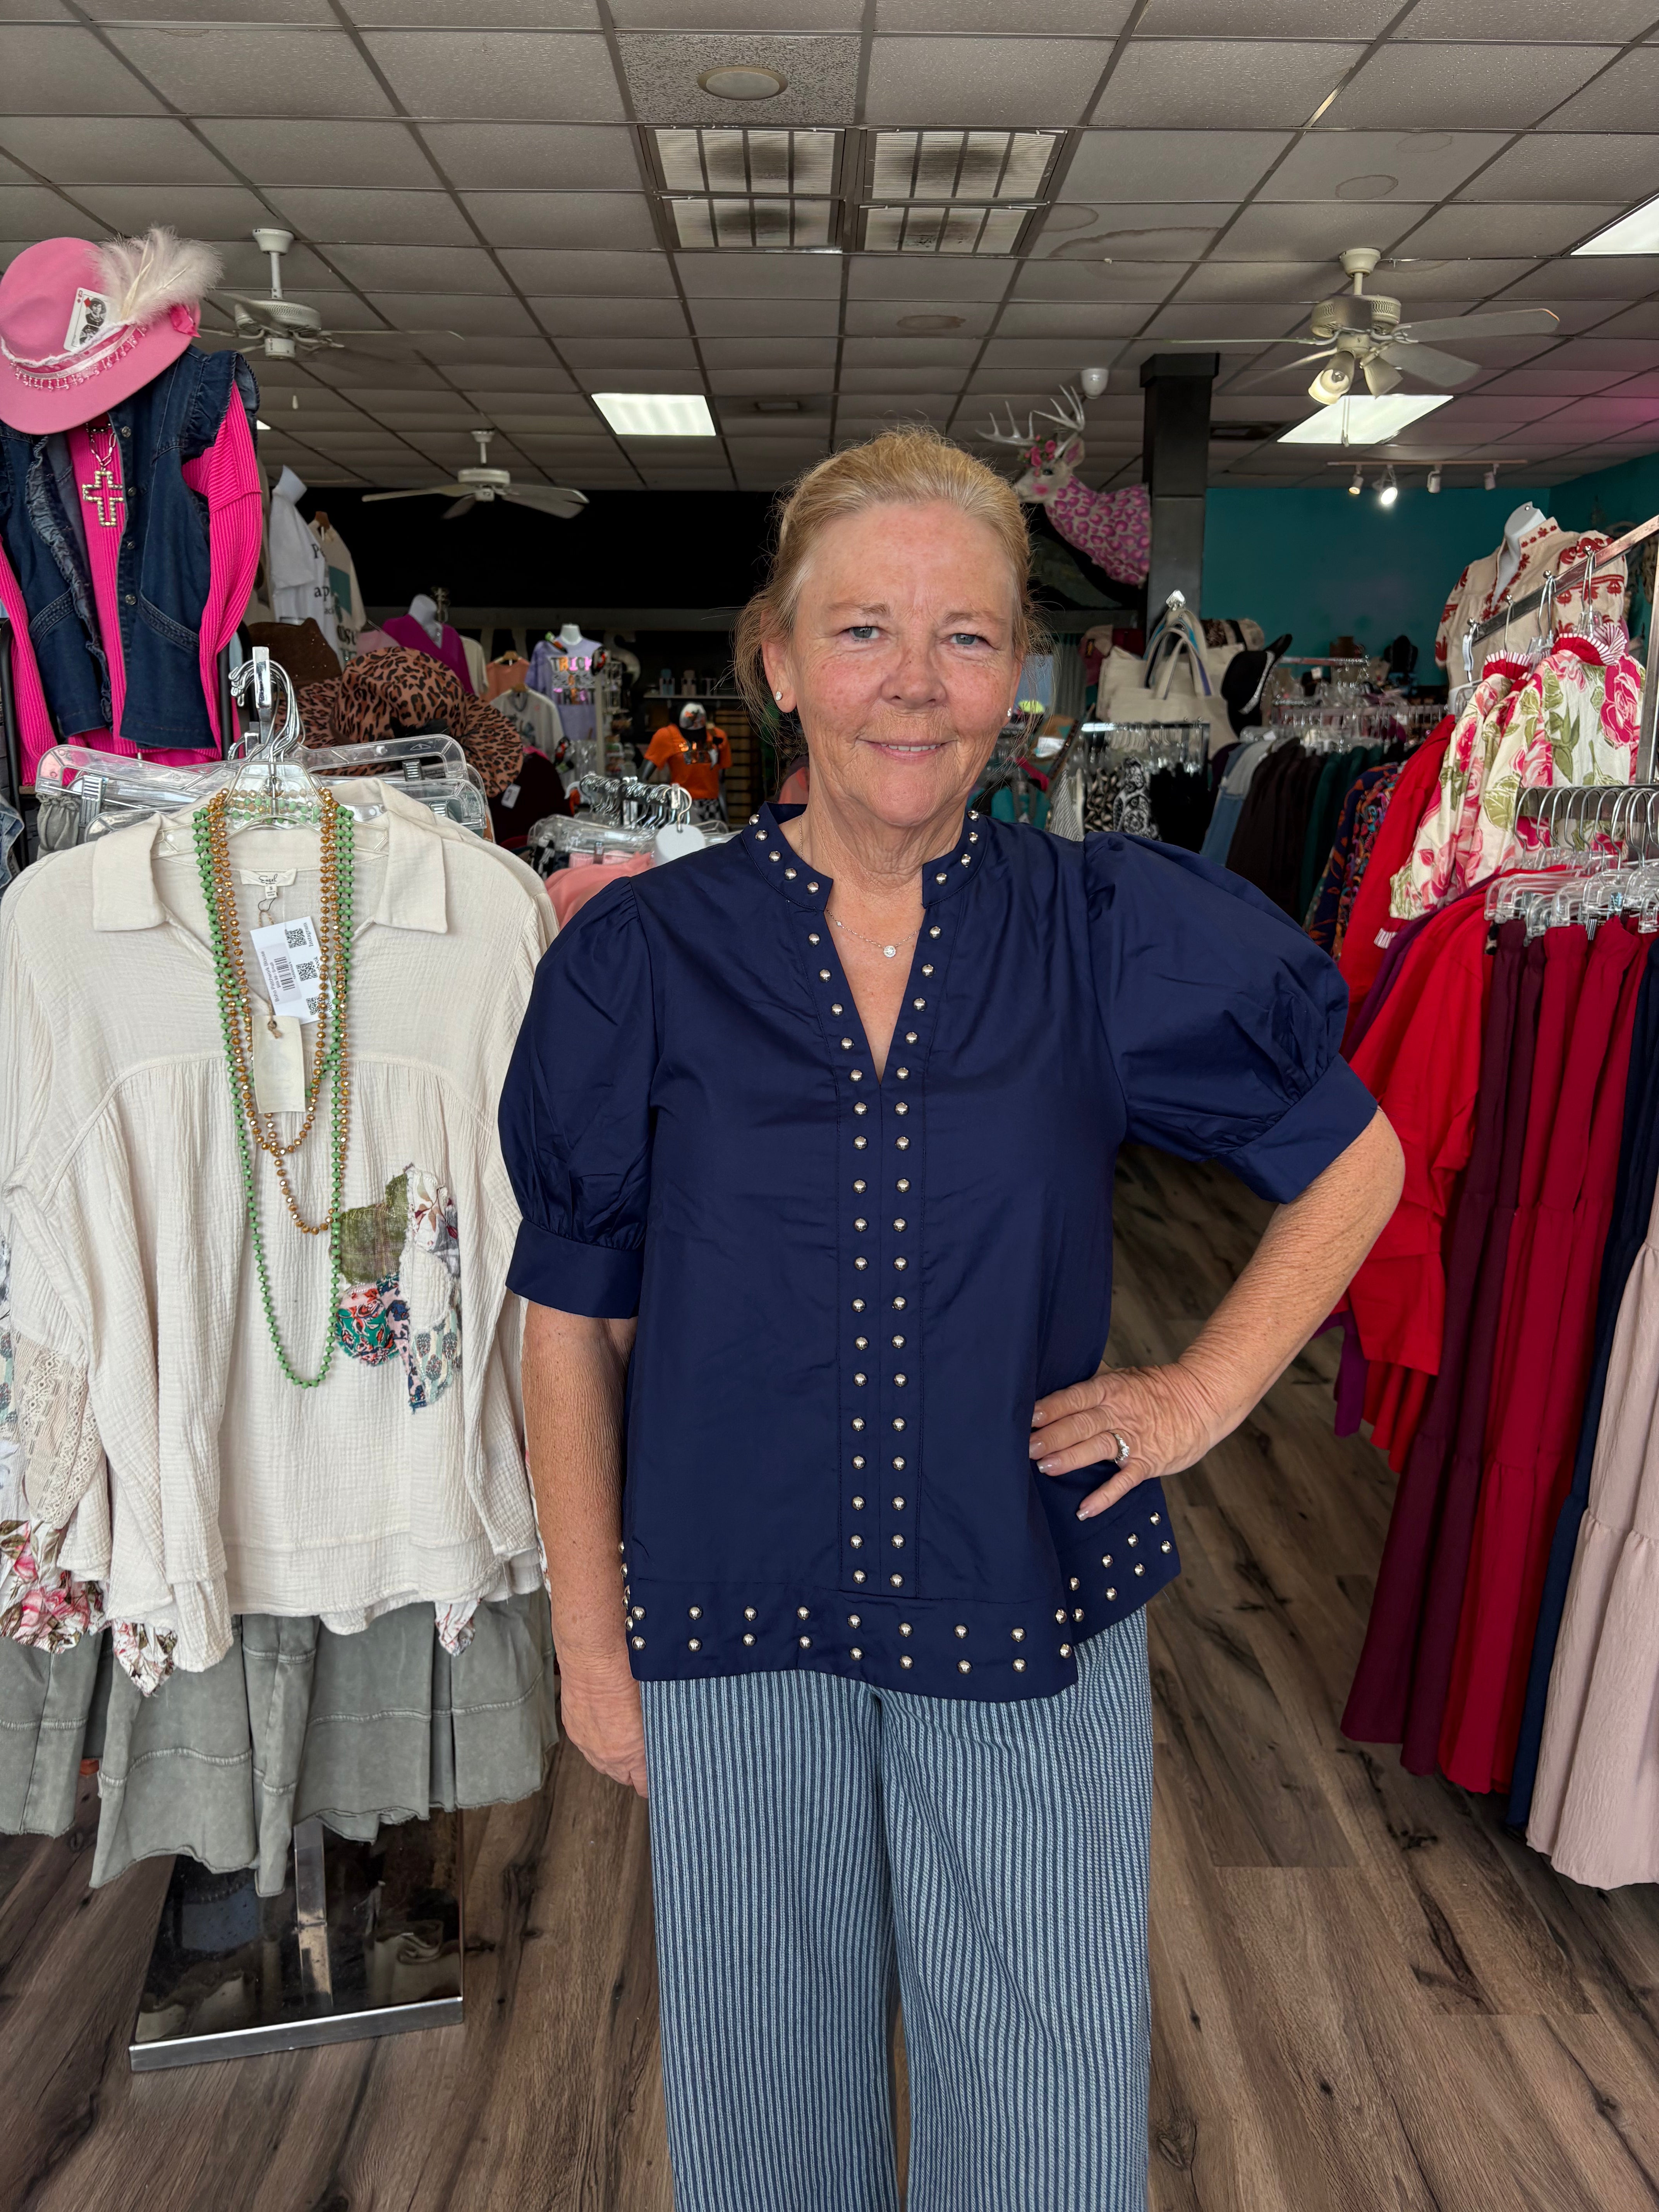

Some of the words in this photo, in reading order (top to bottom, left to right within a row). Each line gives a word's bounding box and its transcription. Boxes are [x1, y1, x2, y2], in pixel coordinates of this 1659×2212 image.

[551, 656, 592, 672] TRICK
[553, 688, 595, 704] TREAT
[304, 922, 314, 947] Instagram
[265, 967, 275, 990] Patchwork
